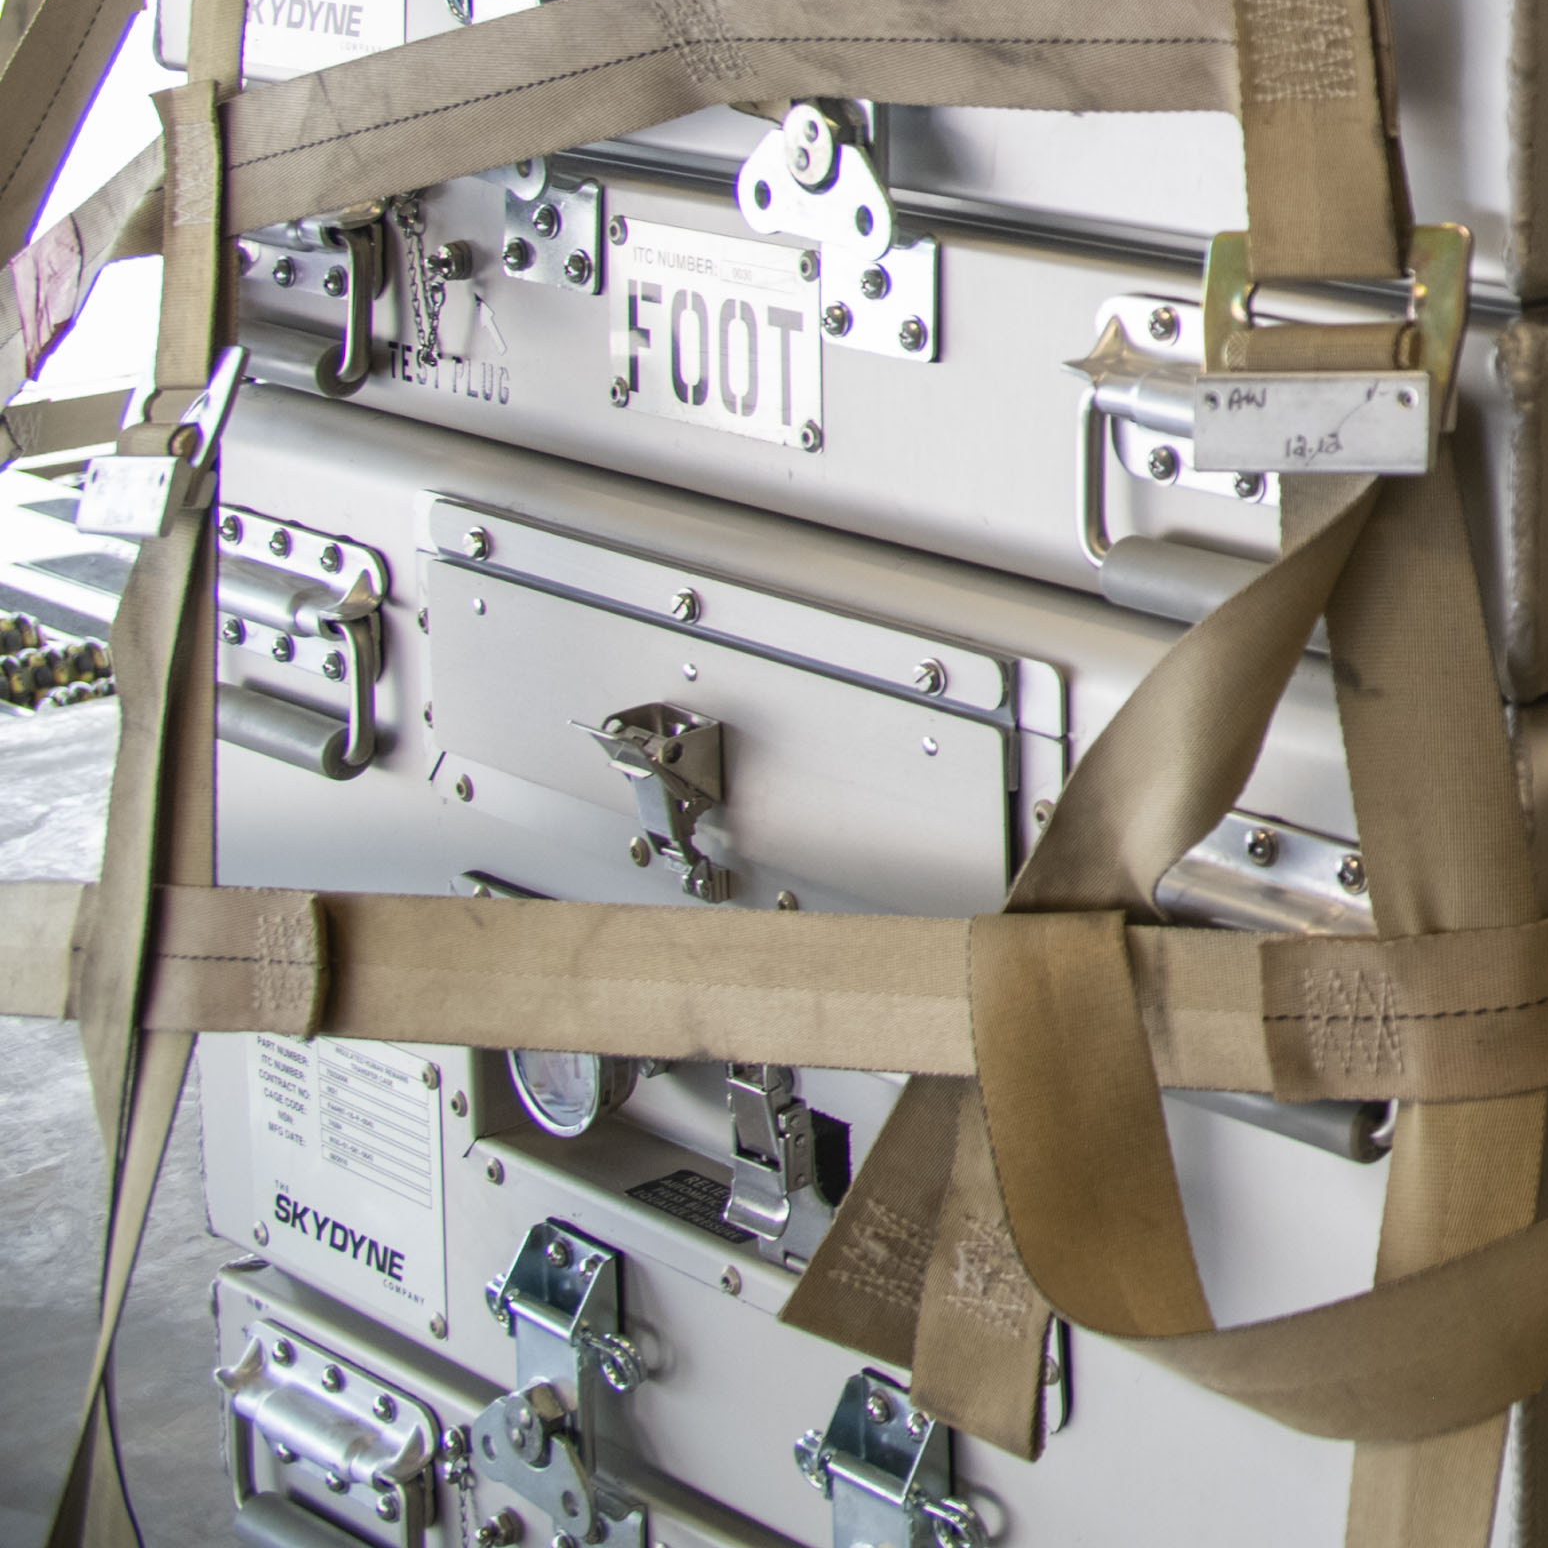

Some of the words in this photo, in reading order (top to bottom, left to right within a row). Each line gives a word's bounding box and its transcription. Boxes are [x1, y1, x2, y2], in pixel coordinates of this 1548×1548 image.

[633, 246, 654, 265] ITC
[657, 251, 718, 277] NUMBER:
[388, 341, 443, 389] TEST
[452, 356, 510, 405] PLUG
[628, 278, 804, 427] FOOT
[274, 1193, 405, 1282] SKYDYNE
[383, 1278, 425, 1306] COMPANY
